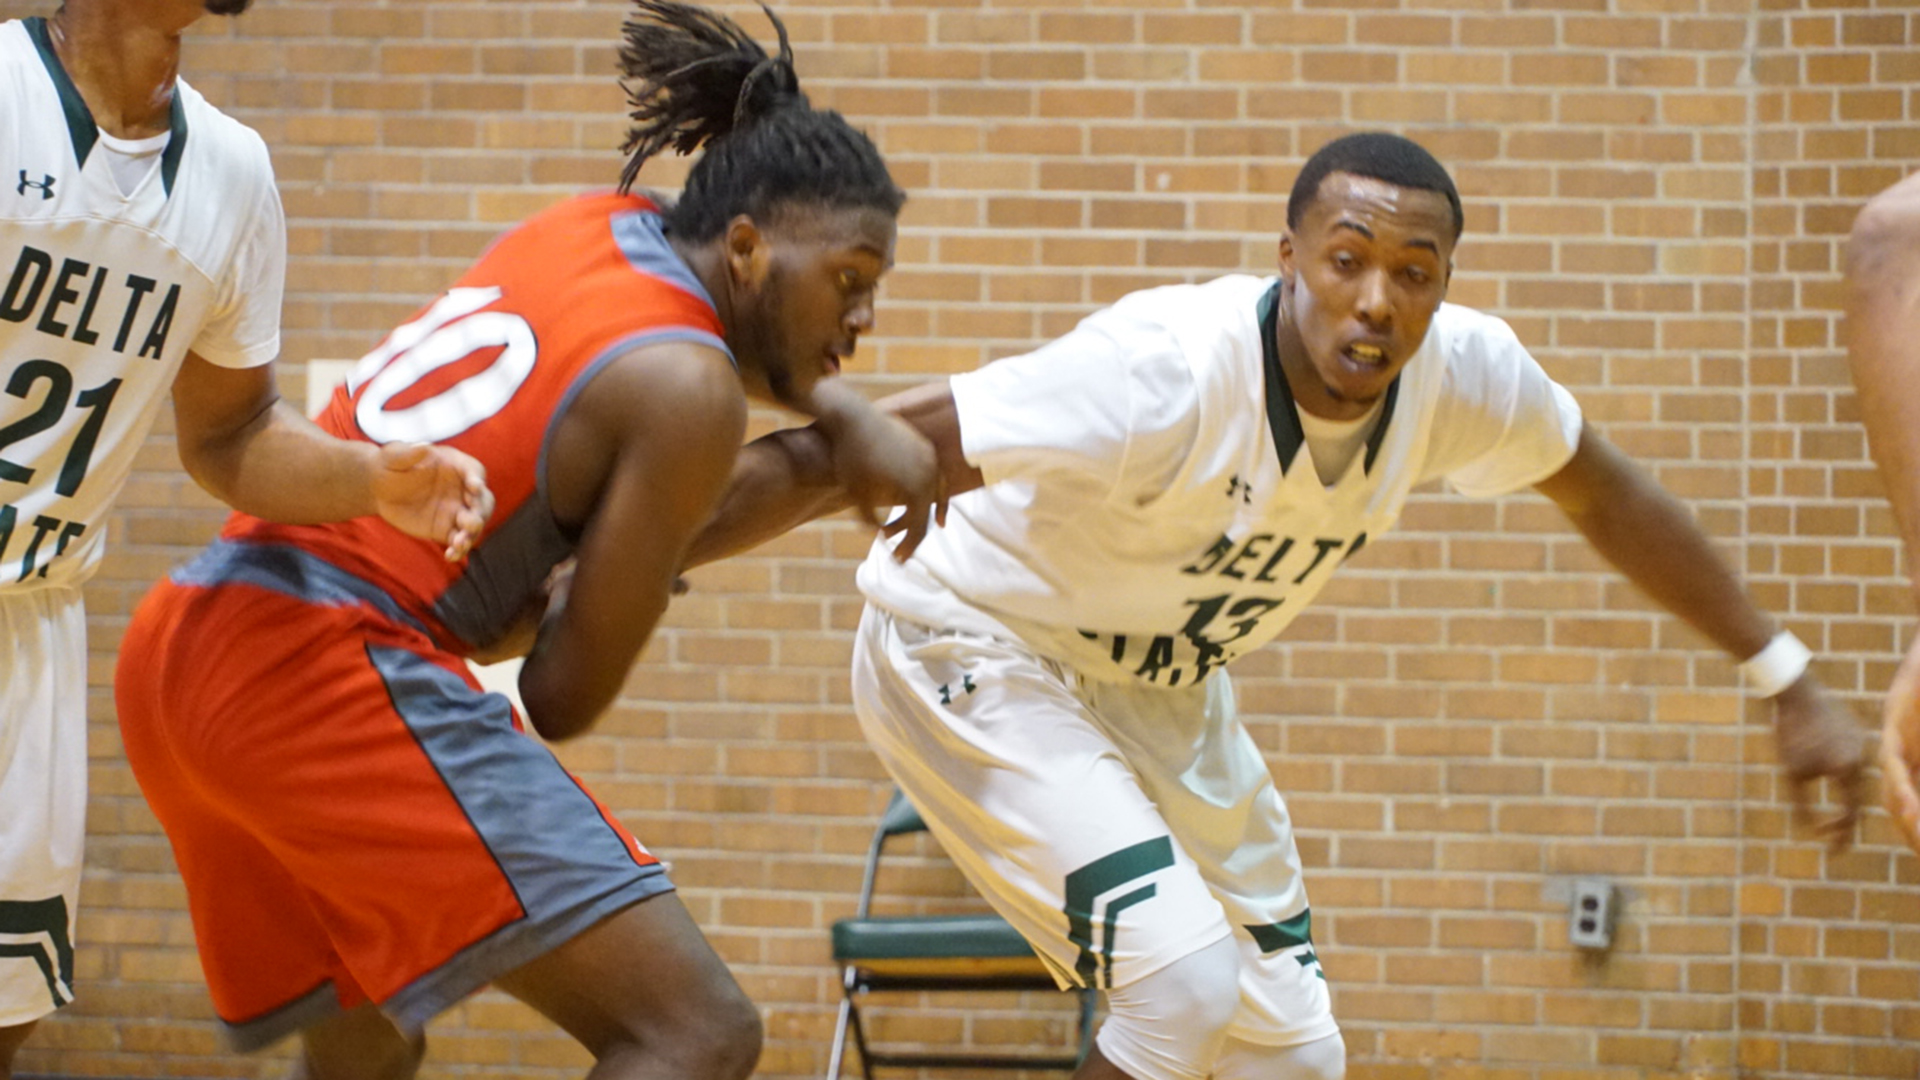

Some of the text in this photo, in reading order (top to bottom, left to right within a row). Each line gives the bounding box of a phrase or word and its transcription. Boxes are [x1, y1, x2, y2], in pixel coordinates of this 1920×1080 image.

[0, 245, 182, 361] DELTA
[345, 285, 539, 445] 10
[0, 359, 124, 499] 21
[1180, 592, 1286, 645] 13
